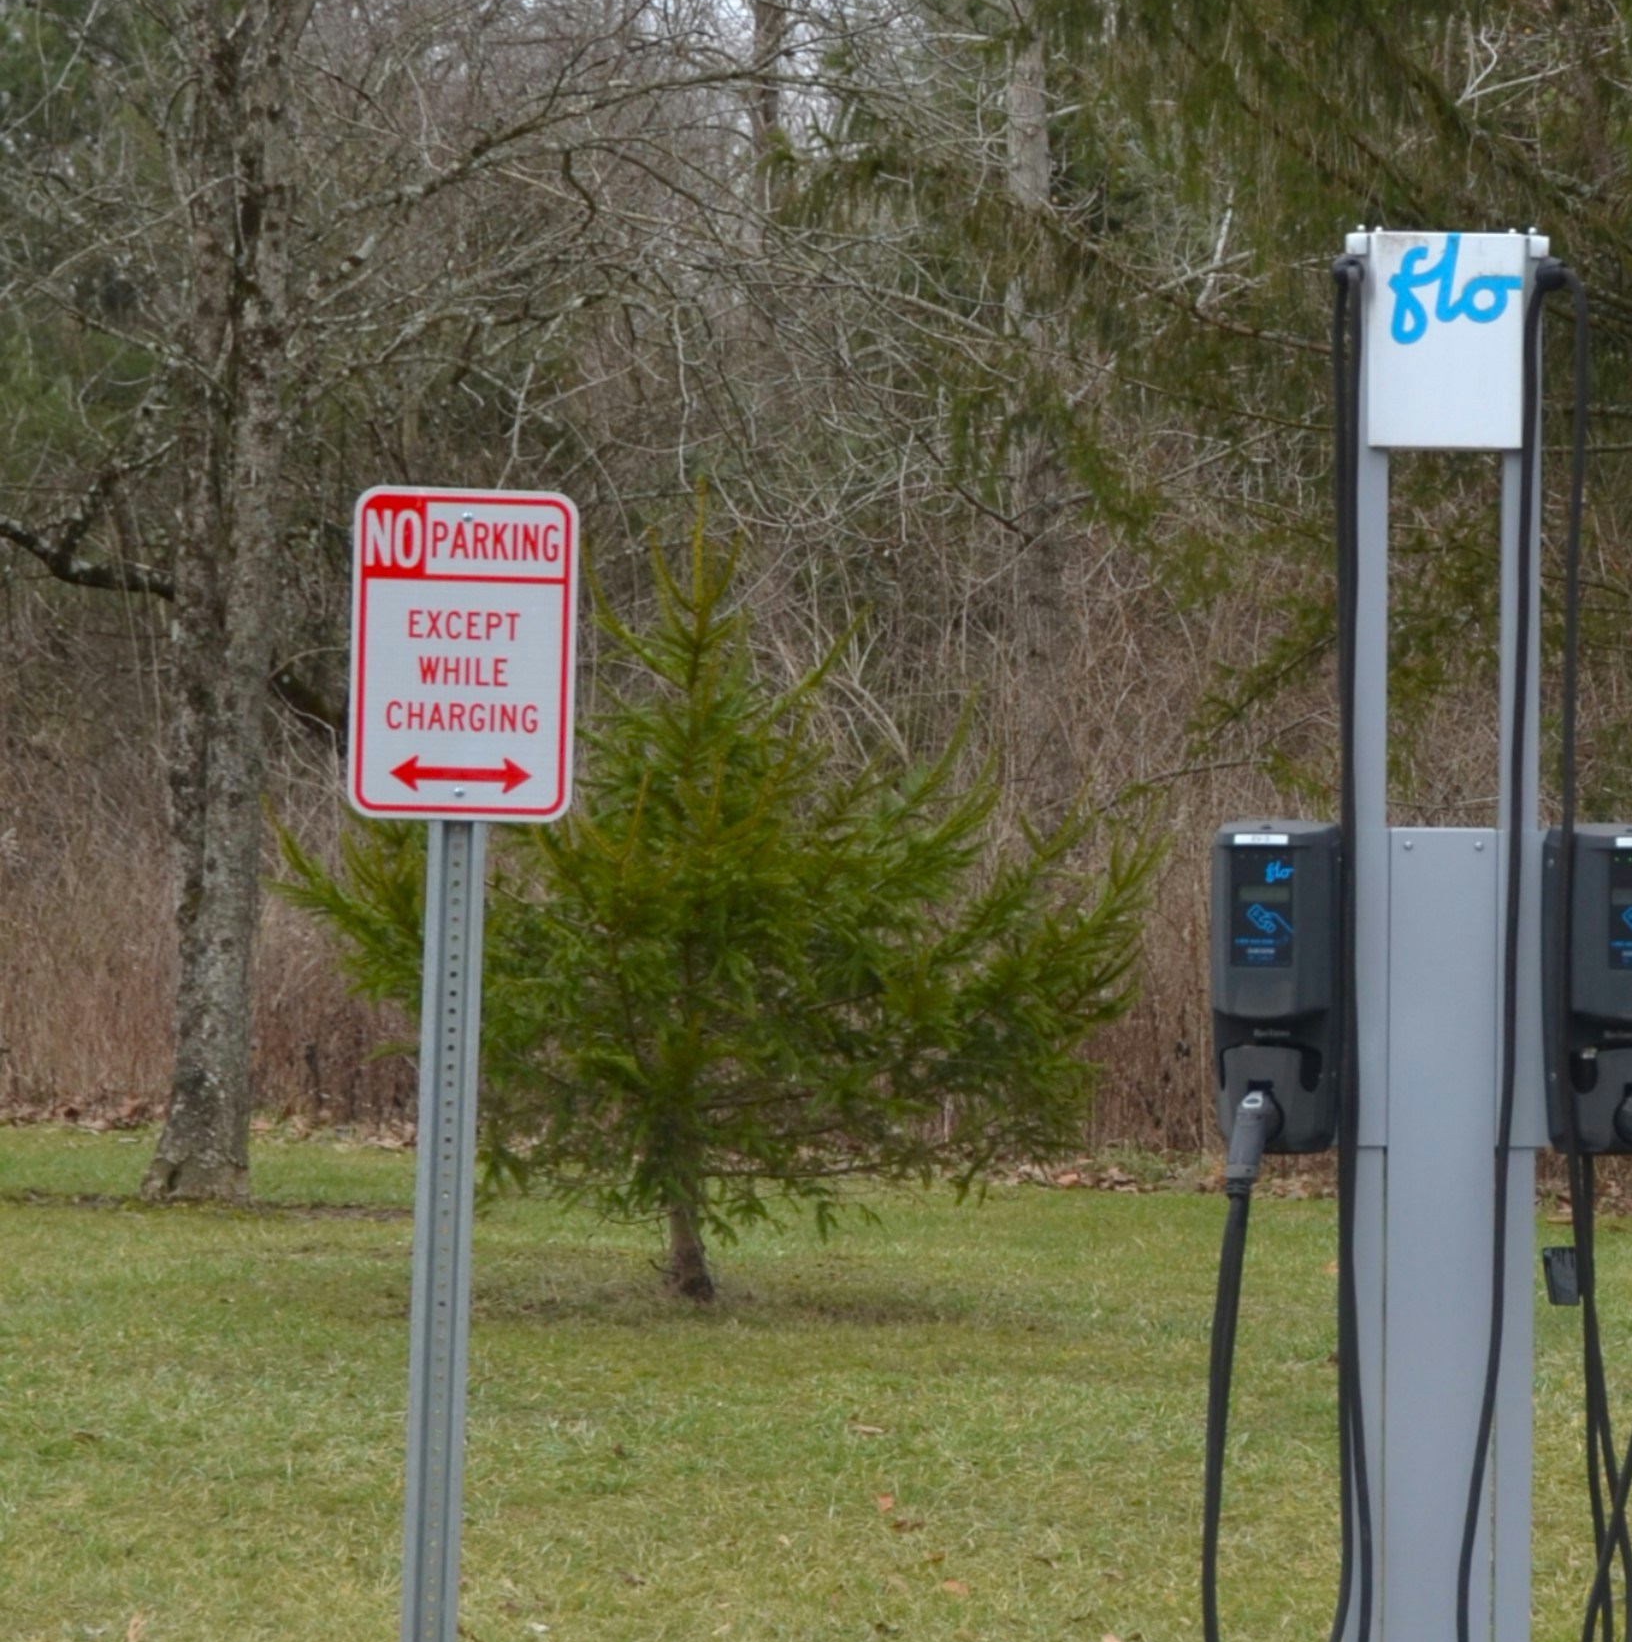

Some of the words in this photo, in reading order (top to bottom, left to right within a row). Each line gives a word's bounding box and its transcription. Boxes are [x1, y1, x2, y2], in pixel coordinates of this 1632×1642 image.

[1388, 232, 1522, 345] flo
[366, 509, 422, 568] NO
[431, 520, 560, 563] PARKING
[408, 609, 520, 641] EXCEPT
[419, 656, 508, 687] WHILE
[385, 700, 538, 734] CHARGING
[1265, 860, 1295, 884] flo
